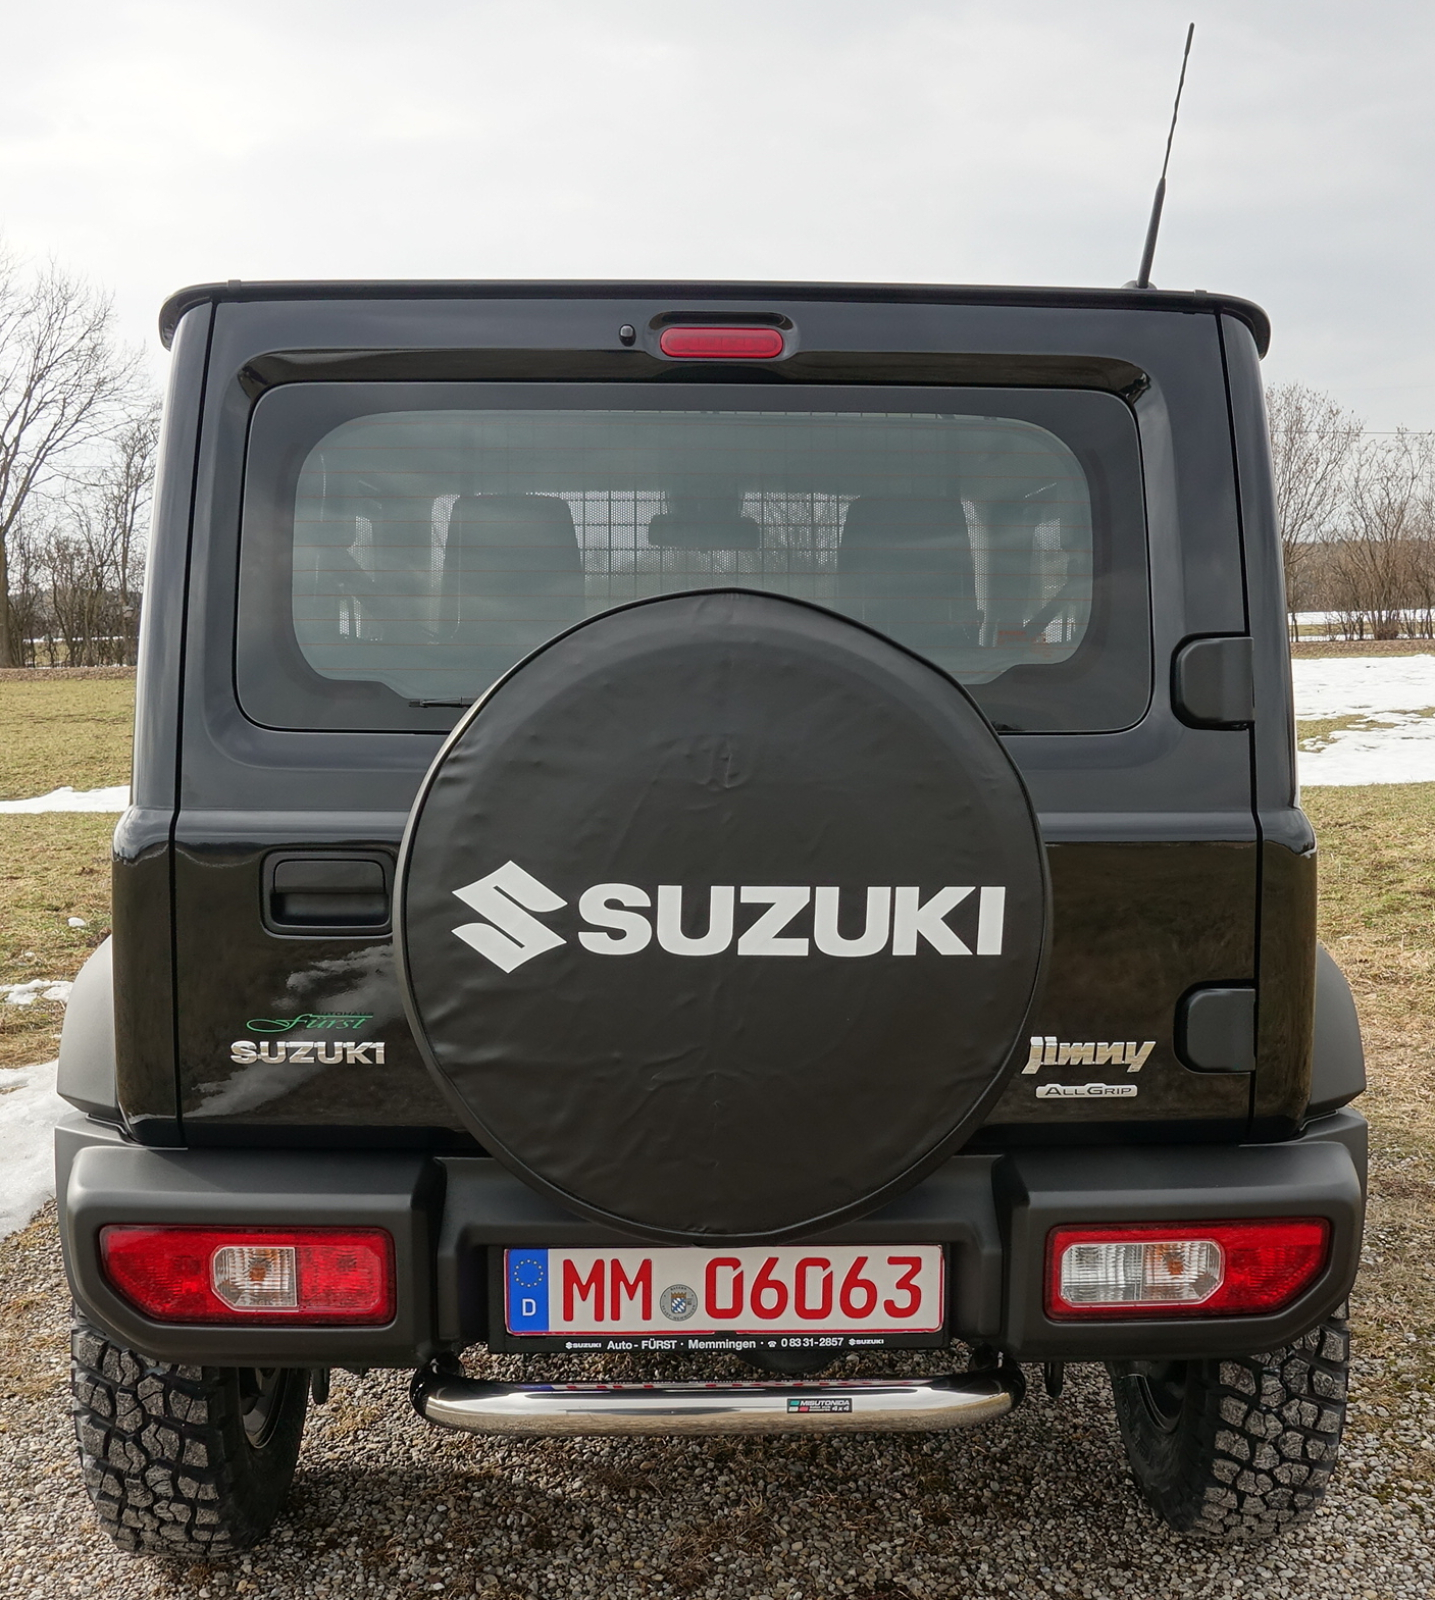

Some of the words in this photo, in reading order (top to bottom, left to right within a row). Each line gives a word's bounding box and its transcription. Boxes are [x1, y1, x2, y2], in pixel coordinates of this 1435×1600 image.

[578, 883, 1006, 957] SUZUKI
[230, 1040, 385, 1064] SUZUKI
[562, 1258, 652, 1322] MM
[705, 1256, 922, 1320] 06063
[522, 1298, 536, 1317] D
[641, 1338, 678, 1350] FÜRST
[688, 1339, 756, 1351] Memmingen
